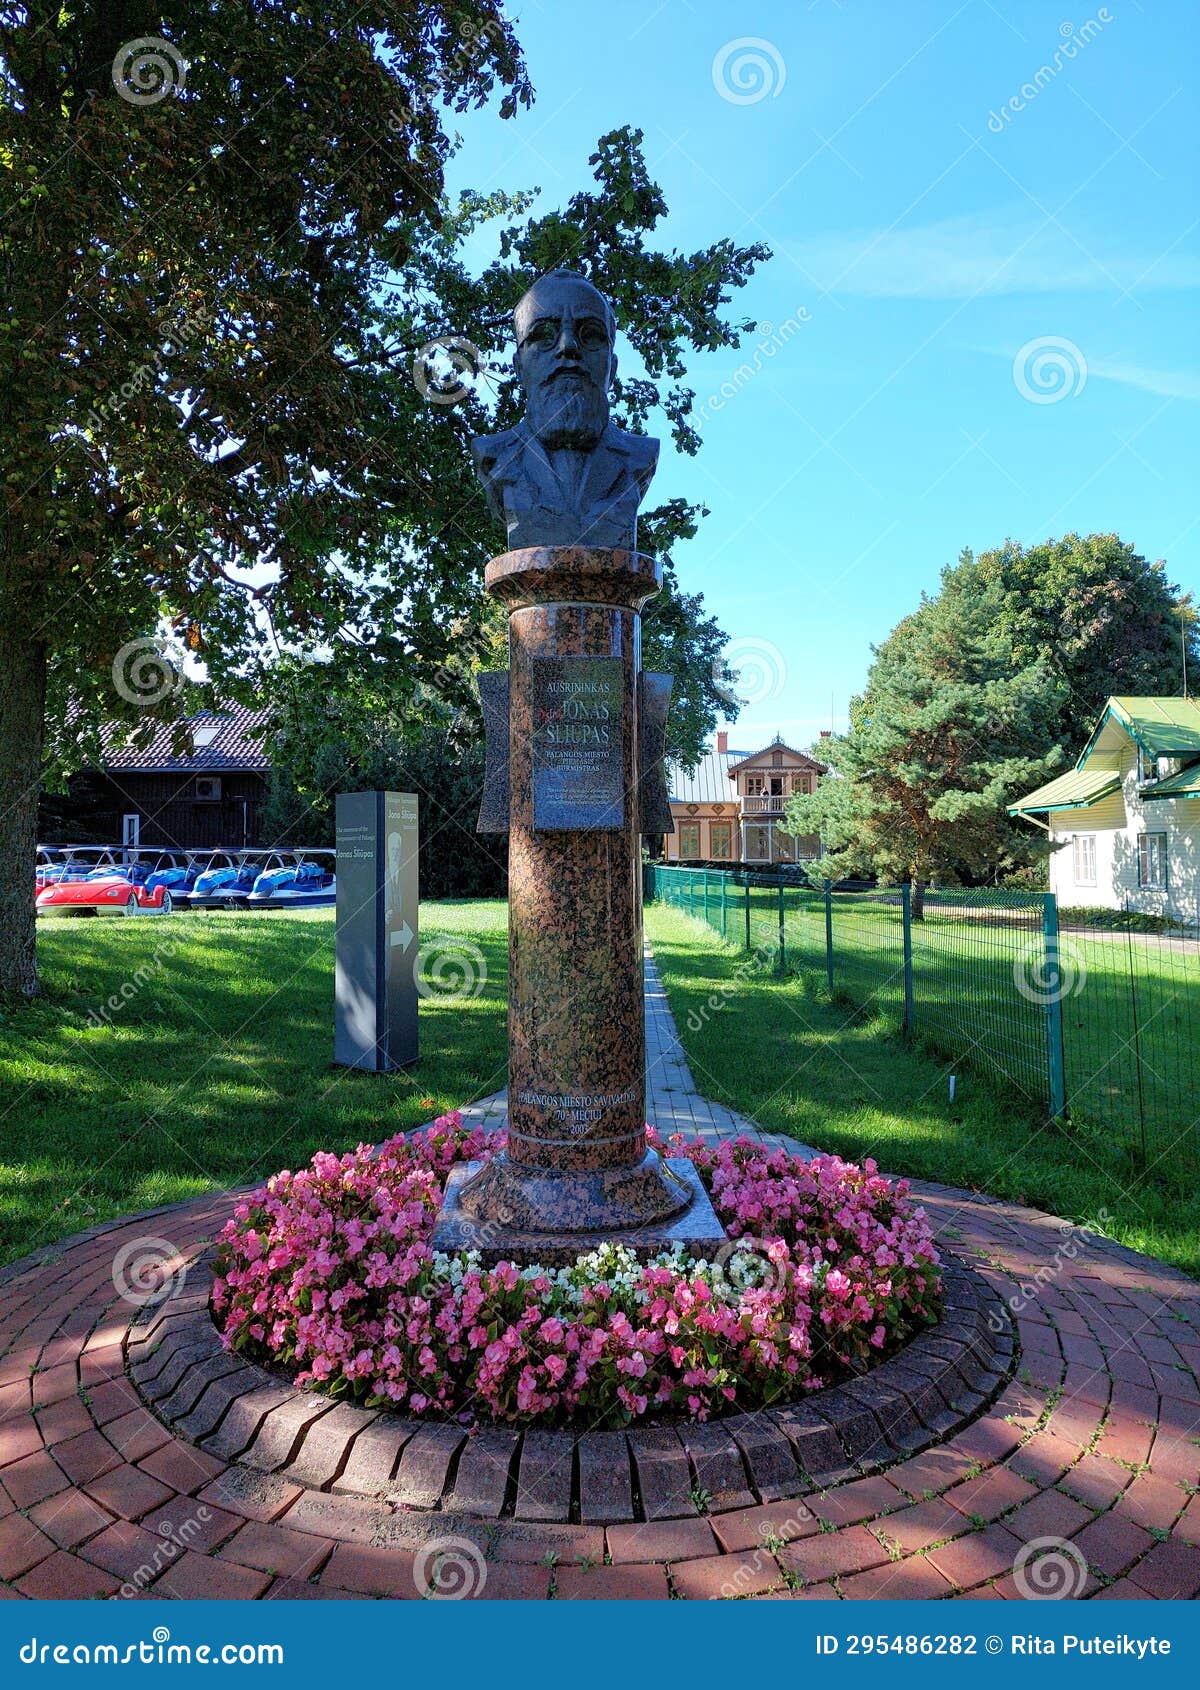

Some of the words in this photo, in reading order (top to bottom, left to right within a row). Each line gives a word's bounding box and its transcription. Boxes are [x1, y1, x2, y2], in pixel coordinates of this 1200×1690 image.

[563, 700, 609, 720] JONAS
[336, 849, 352, 858] Jonas
[560, 1095, 592, 1107] MIESTO
